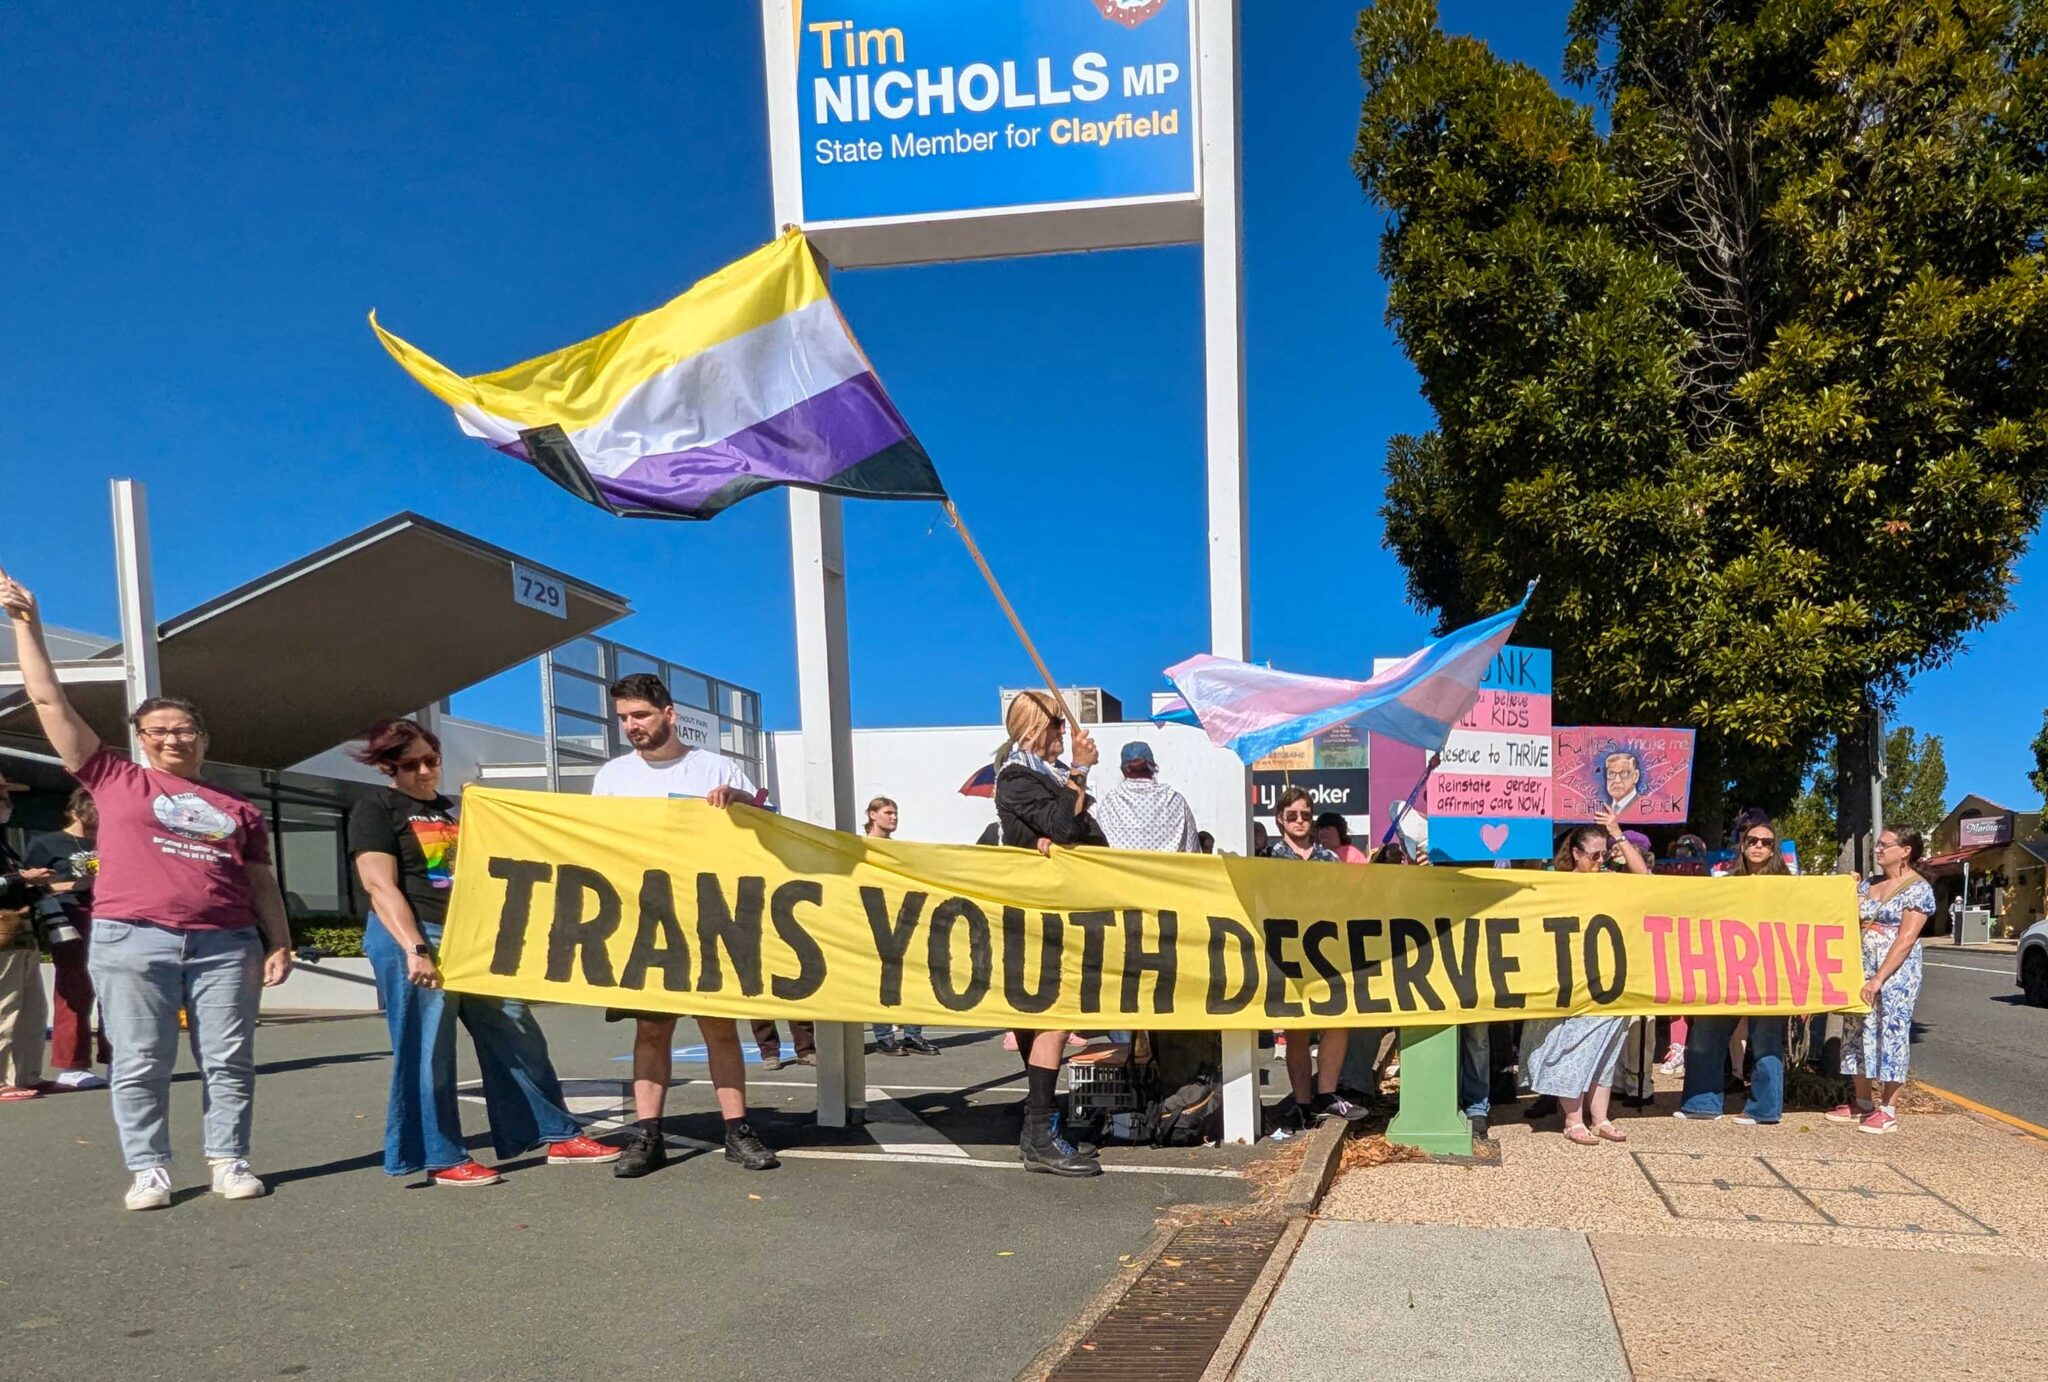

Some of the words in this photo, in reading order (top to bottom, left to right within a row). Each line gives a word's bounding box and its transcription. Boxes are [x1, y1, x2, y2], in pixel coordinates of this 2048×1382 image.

[809, 20, 905, 69] Tim
[814, 52, 1109, 124] NICHOLLS
[1123, 62, 1179, 97] MP
[815, 134, 883, 164] State
[891, 129, 998, 159] Member
[1005, 124, 1041, 148] for
[1050, 109, 1178, 146] Clayfield
[520, 575, 560, 607] 729
[1480, 650, 1537, 688] NK
[1494, 690, 1529, 708] believe
[1491, 705, 1530, 728] KIDS
[674, 724, 708, 744] IATRY
[1488, 743, 1501, 764] to
[1261, 785, 1276, 809] LJ
[1438, 775, 1491, 793] Reinstate
[1503, 778, 1542, 796] gender
[1437, 796, 1485, 815] affirming
[1489, 799, 1513, 811] care
[1518, 787, 1547, 815] NOW!
[488, 857, 827, 1000] TRANS
[860, 886, 1178, 1014] YOUTH
[1205, 916, 1525, 1018] DESERVE
[1543, 914, 1628, 1008] TO
[1643, 915, 1849, 1007] THRIVE
